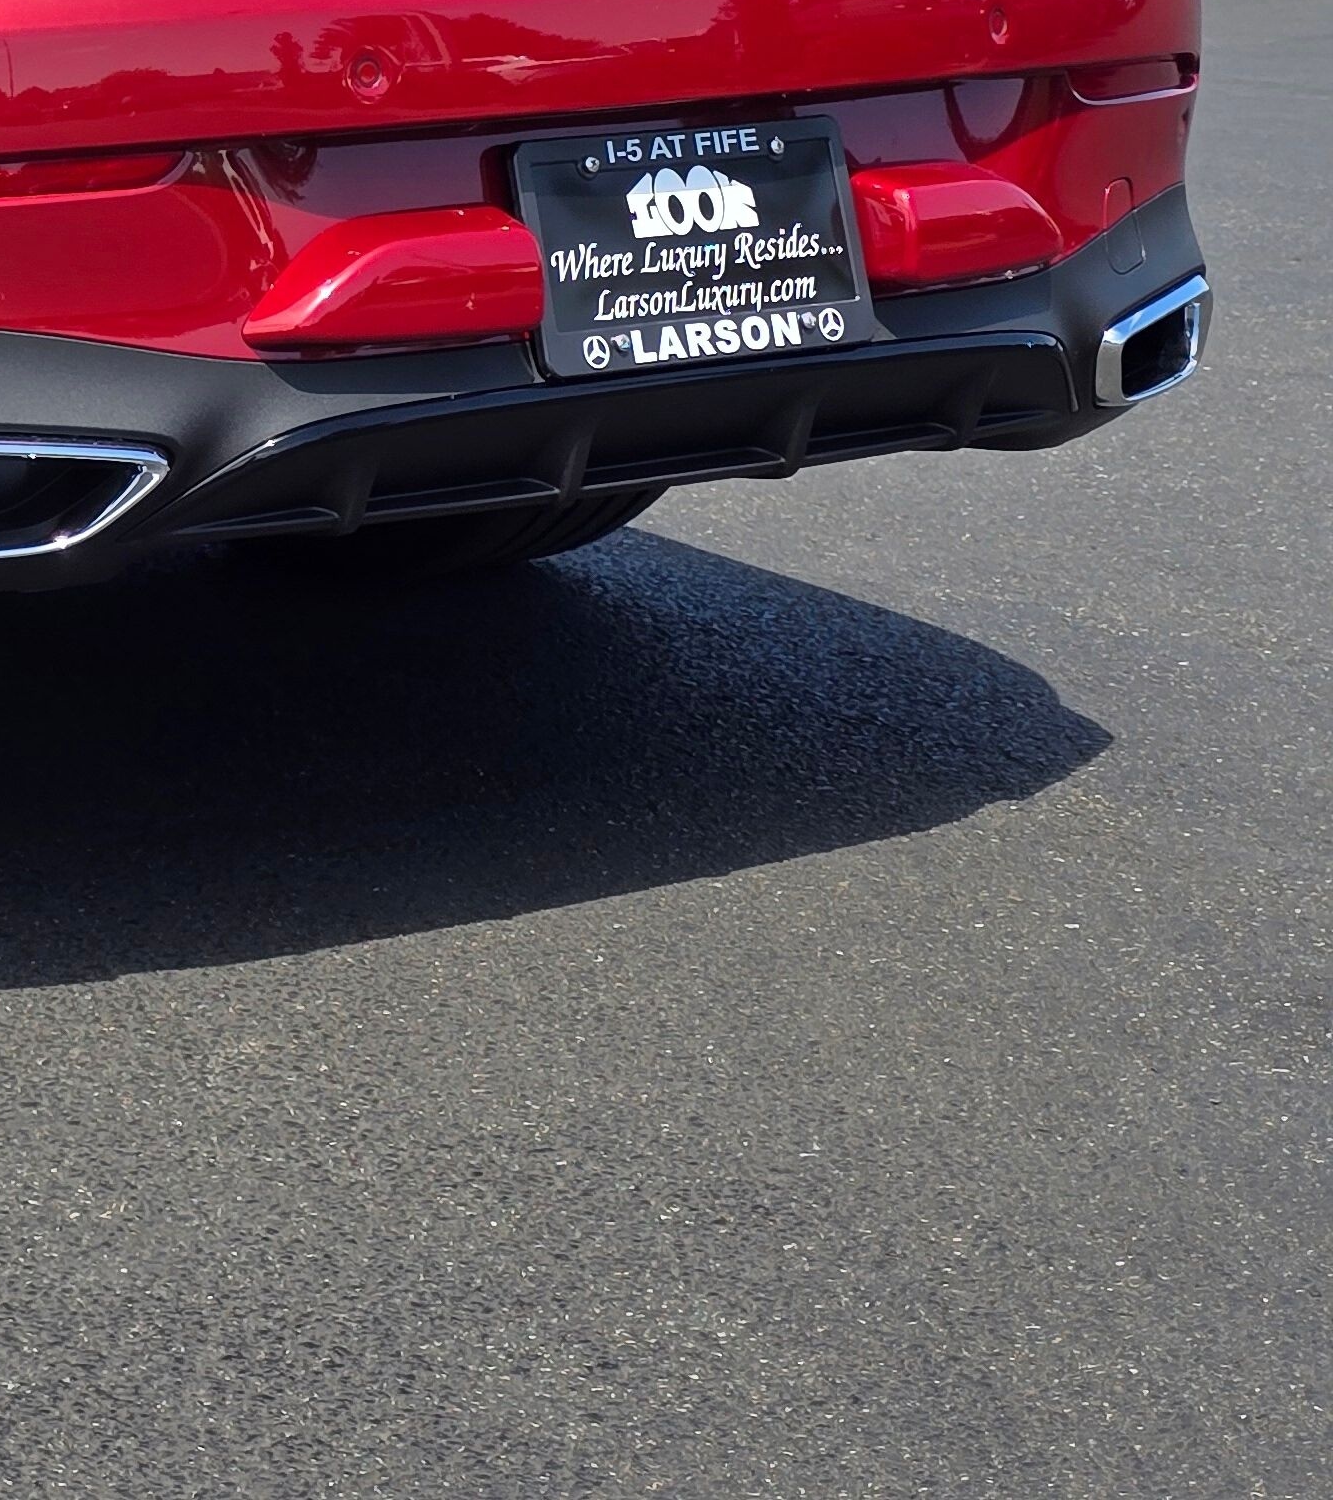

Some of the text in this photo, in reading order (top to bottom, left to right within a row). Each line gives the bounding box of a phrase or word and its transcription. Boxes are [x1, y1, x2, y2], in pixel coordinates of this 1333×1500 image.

[606, 128, 760, 164] I-5 AT FIFE
[550, 222, 844, 283] Where Luxury Resides...
[593, 274, 817, 321] LarsonLuxury.com
[630, 311, 802, 364] LARSON
